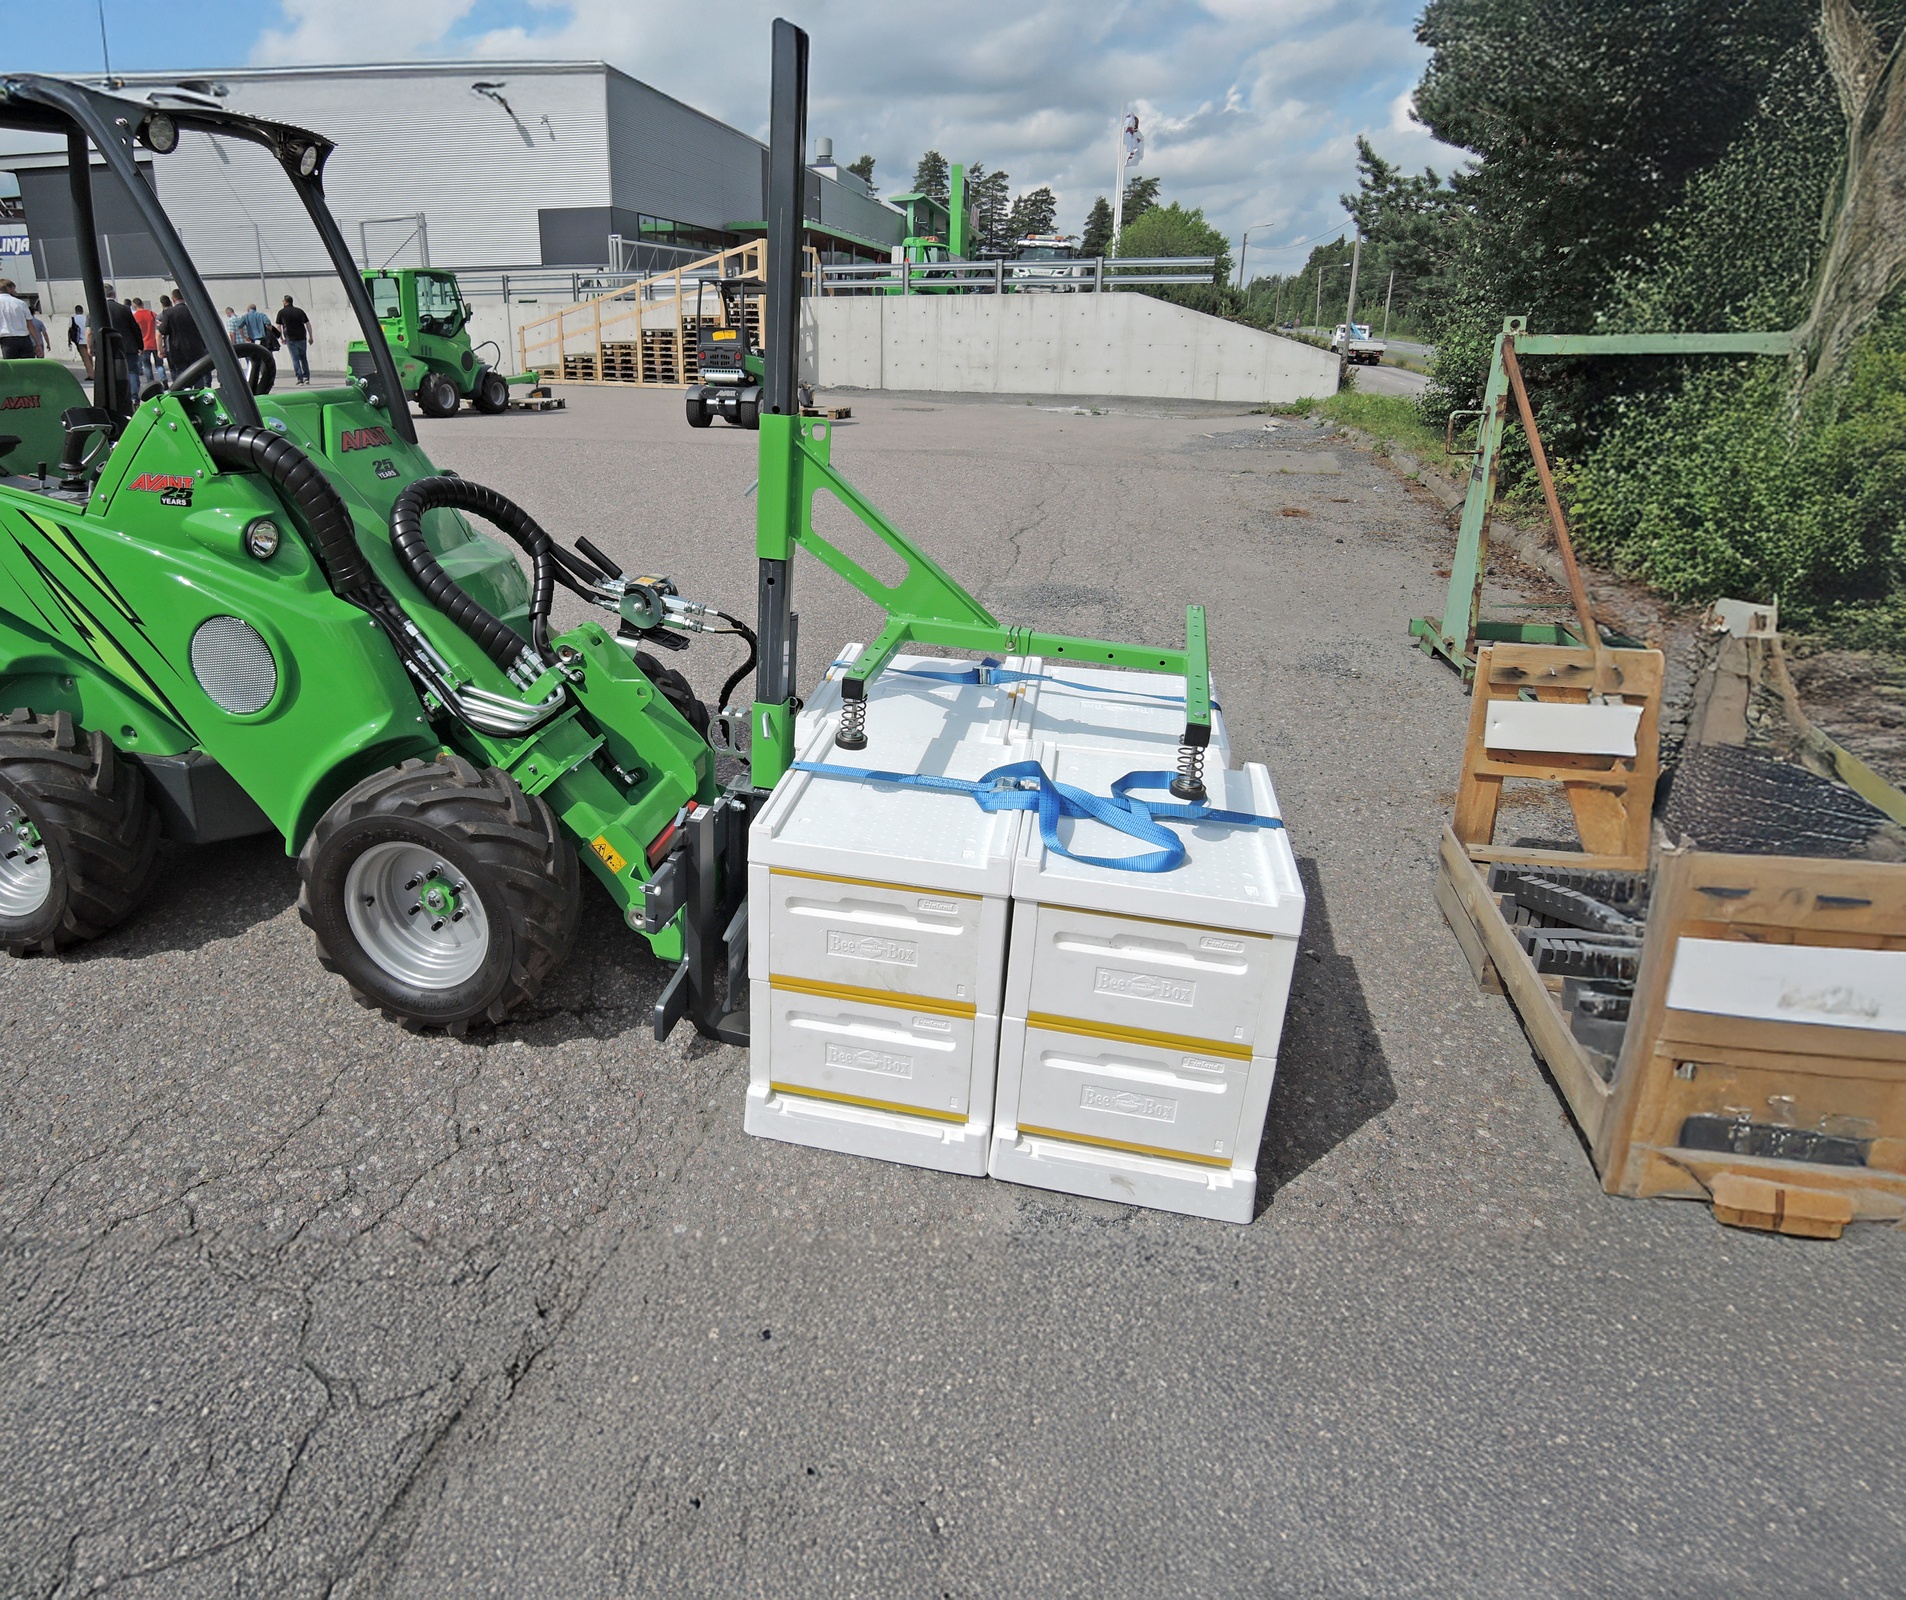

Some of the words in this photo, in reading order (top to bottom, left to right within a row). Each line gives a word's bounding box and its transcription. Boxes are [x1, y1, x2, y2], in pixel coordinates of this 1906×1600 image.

[1, 395, 40, 410] AVANT
[342, 426, 393, 453] AVANT
[372, 458, 394, 471] 25
[378, 469, 397, 479] YEARS
[126, 472, 195, 493] AVANT
[161, 487, 194, 499] 25
[161, 497, 187, 506] YEARS
[830, 934, 856, 953] Bee
[886, 943, 914, 962] Box
[1098, 971, 1126, 991] Bee
[1159, 981, 1190, 1001] Box
[828, 1046, 853, 1064] Bee
[881, 1056, 910, 1074] Box
[1083, 1088, 1110, 1107] Bee
[1142, 1099, 1172, 1118] Box
